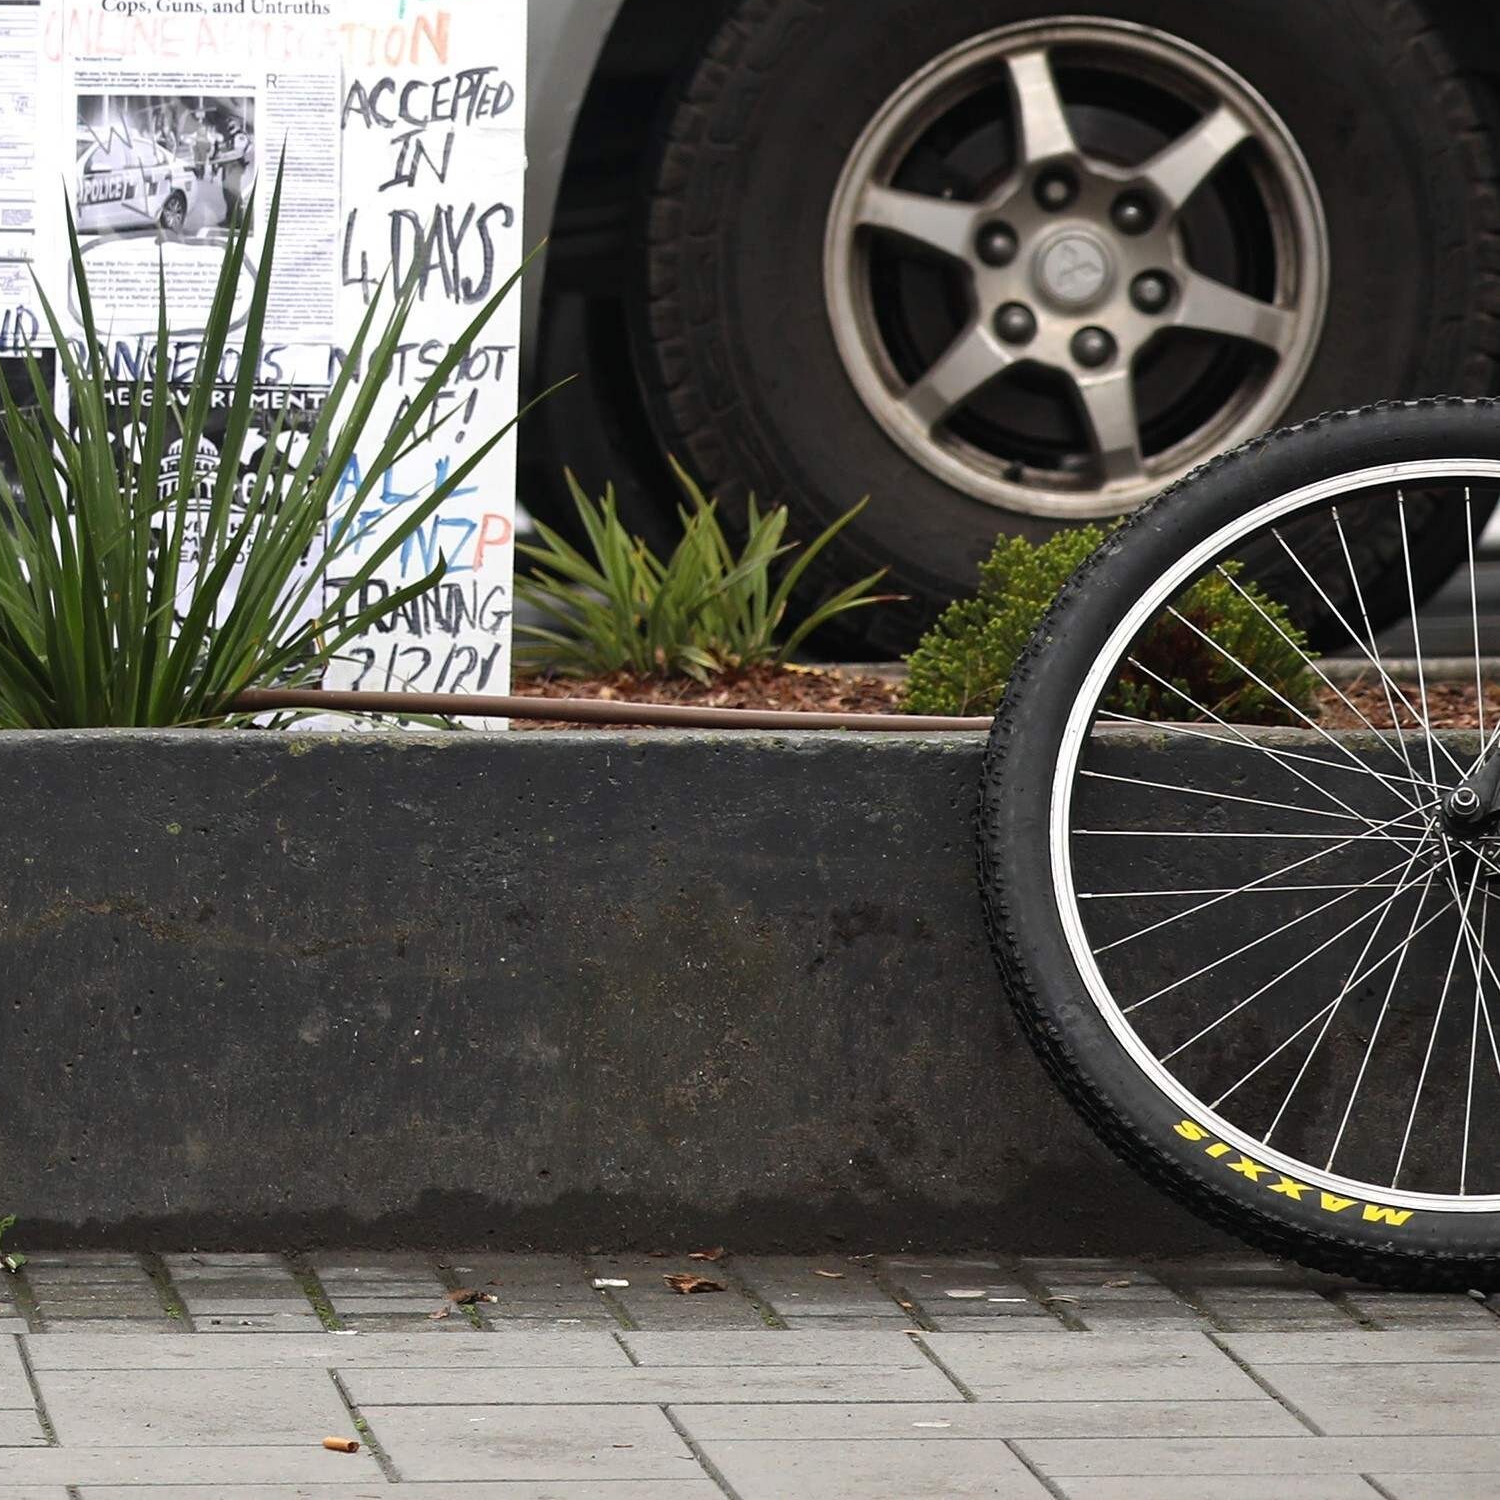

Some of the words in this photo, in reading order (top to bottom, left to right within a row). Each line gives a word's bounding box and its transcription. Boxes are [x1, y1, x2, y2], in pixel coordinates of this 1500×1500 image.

[341, 66, 515, 131] ACCEPTED
[83, 177, 124, 203] POLICE
[378, 128, 457, 192] IN
[341, 207, 382, 305] 4
[387, 202, 515, 305] DAYS
[139, 388, 326, 409] GVRMENT
[334, 453, 479, 505] ALL
[324, 576, 513, 639] TRAINING
[1173, 1119, 1415, 1226] MAXXIS
